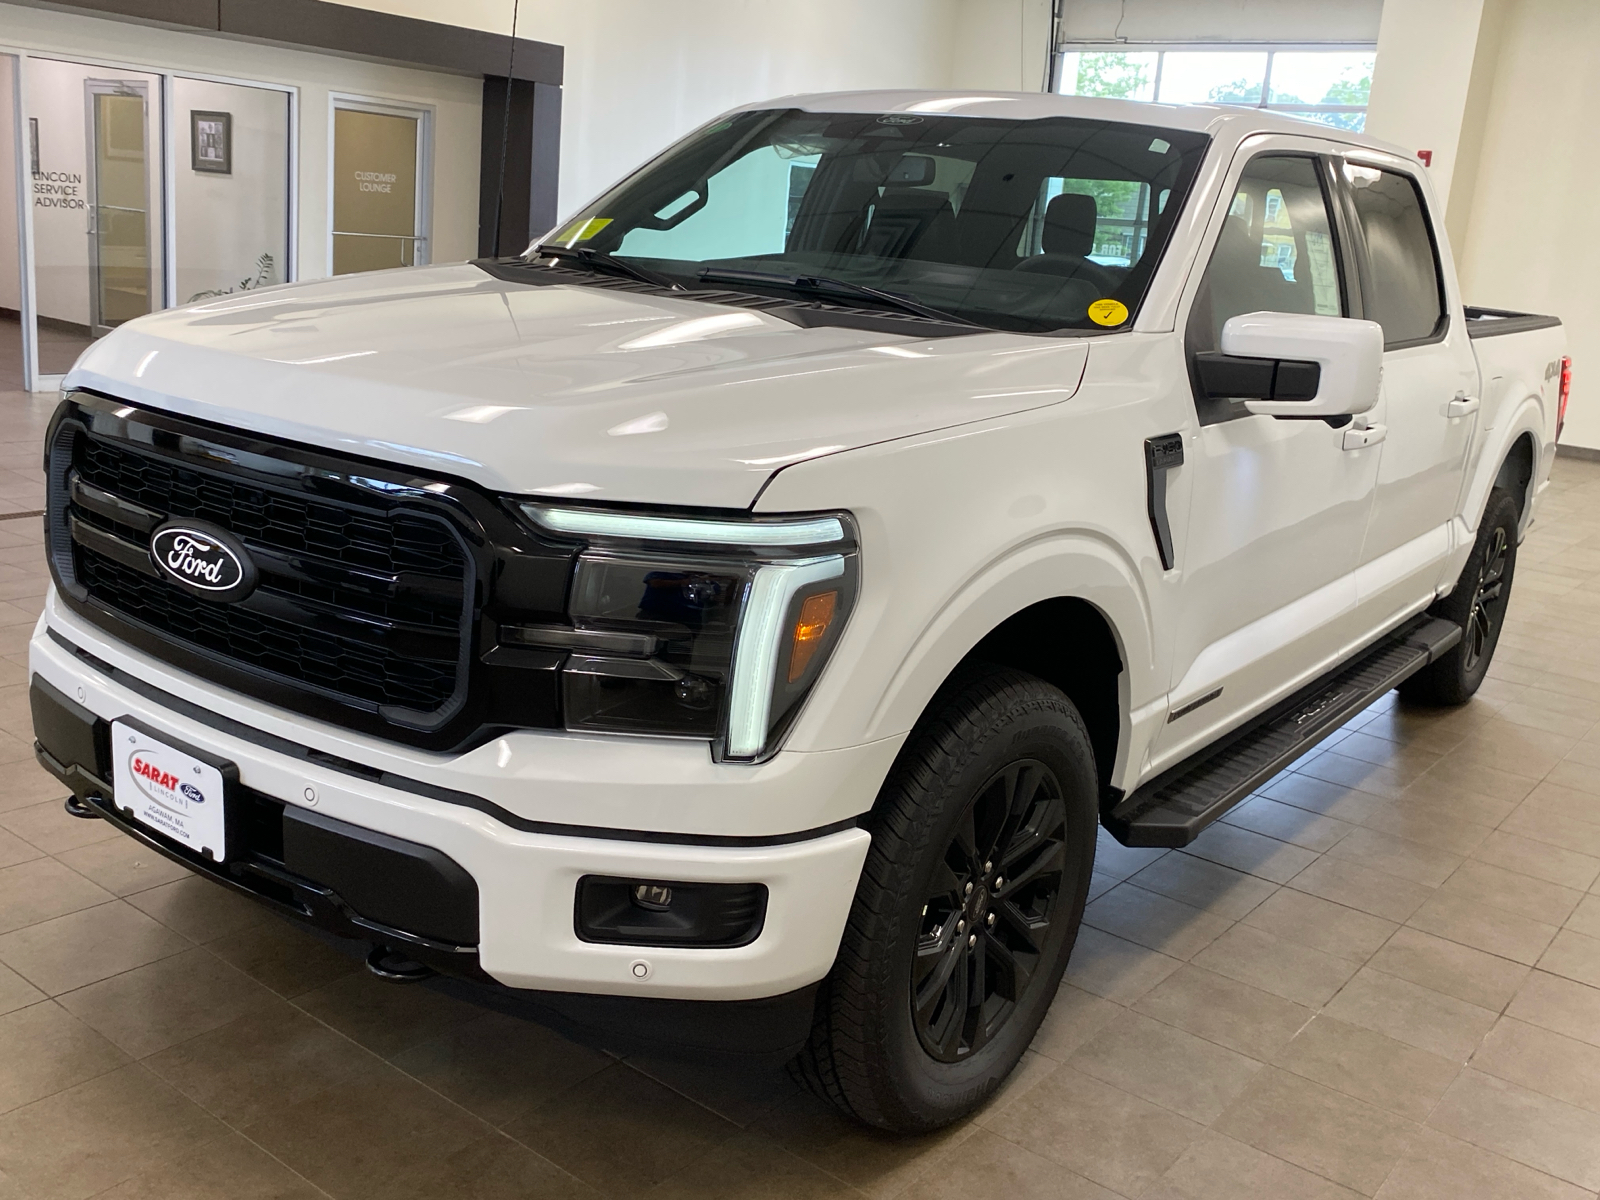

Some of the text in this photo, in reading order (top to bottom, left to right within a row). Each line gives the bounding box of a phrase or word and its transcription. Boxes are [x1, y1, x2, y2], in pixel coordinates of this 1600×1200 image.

[33, 171, 81, 184] LINCOLN
[354, 171, 396, 183] CUSTOMER
[33, 183, 78, 196] SERVICE
[359, 182, 392, 193] LOUNGE
[34, 197, 84, 209] ADVISOR
[168, 535, 224, 583] Ford
[133, 757, 179, 792] SARAT
[153, 785, 184, 805] LINCOLN
[184, 783, 202, 802] Ford
[148, 804, 184, 828] AGAWAM, MA
